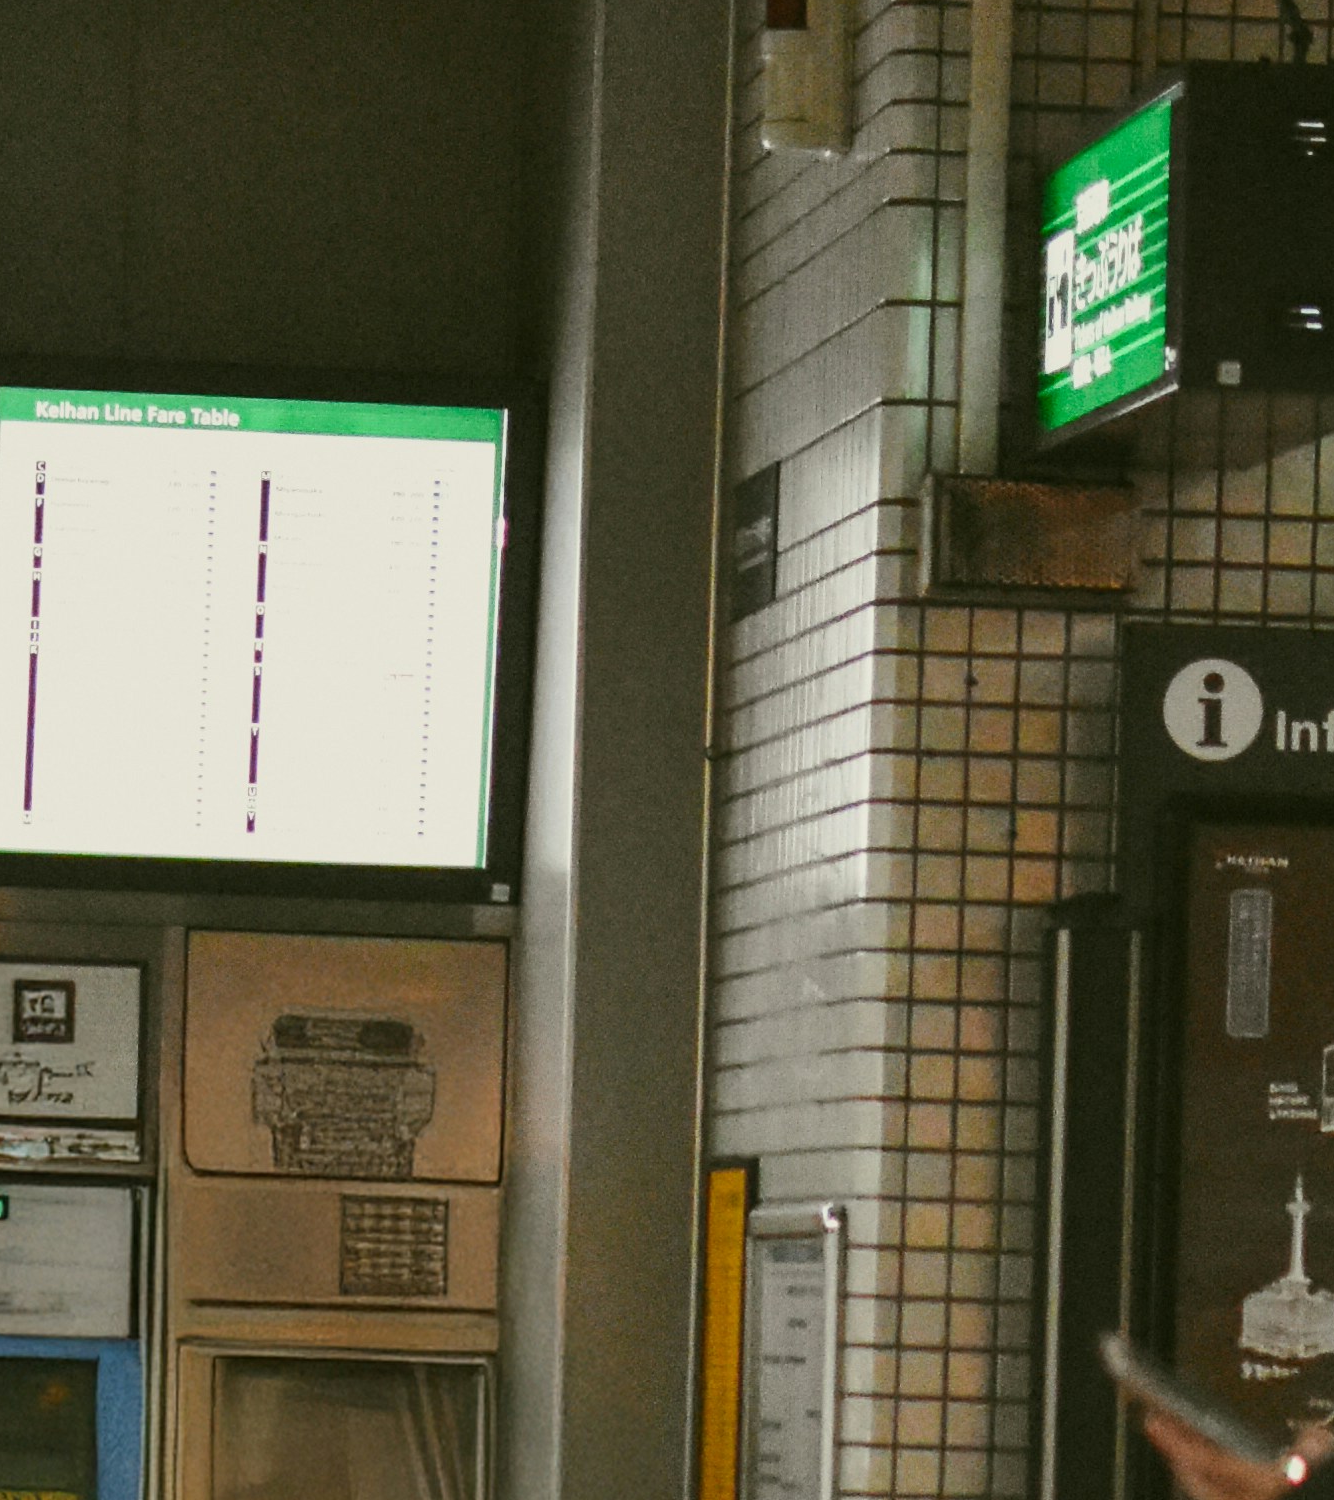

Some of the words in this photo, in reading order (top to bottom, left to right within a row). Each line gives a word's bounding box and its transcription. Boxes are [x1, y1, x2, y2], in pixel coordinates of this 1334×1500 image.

[1075, 212, 1142, 311] きっぷうりば
[35, 400, 98, 423] Keihan
[104, 402, 141, 424] Line
[147, 404, 187, 426] Fare
[191, 405, 240, 428] Table
